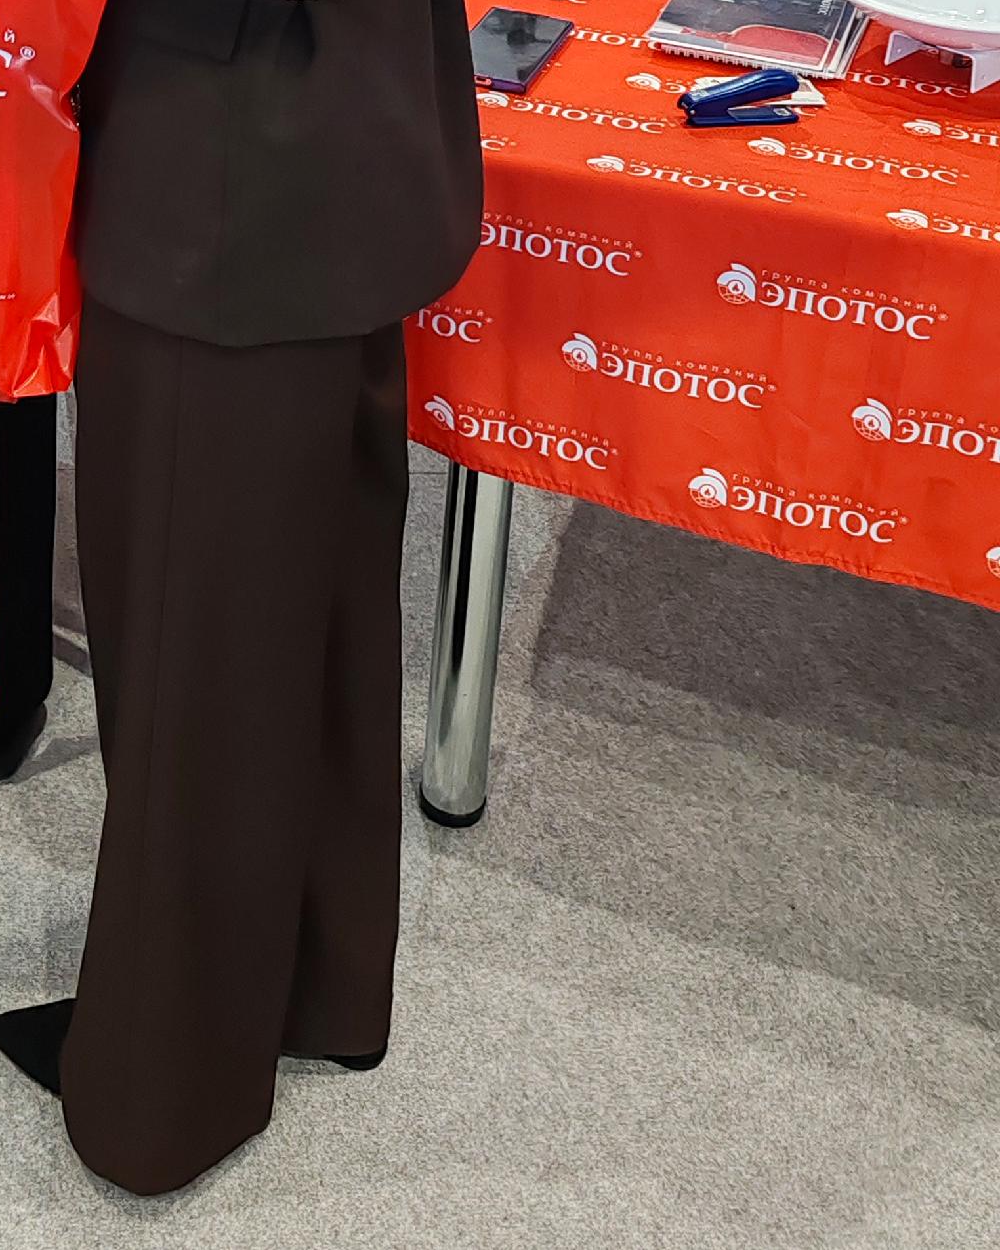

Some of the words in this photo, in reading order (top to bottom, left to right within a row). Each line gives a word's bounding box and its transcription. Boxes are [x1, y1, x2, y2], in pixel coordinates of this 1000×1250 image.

[511, 99, 666, 134] ЭПОТОС
[627, 164, 796, 204] ЭПОТОС
[789, 147, 958, 186] ЭПОТОС
[480, 221, 631, 277] ЭПОТОС
[484, 210, 534, 229] руппа
[545, 225, 633, 250] компаний
[758, 280, 935, 341] ЭПОТОС
[761, 269, 829, 290] группа
[841, 285, 938, 313] компаний
[599, 352, 766, 409] ЭПОТОС
[602, 339, 664, 363] группа
[676, 359, 768, 384] компаний
[526, 418, 610, 448] компаний
[897, 406, 966, 425] группа
[457, 414, 609, 471] ЭПОТОС
[729, 485, 897, 544] ЭПОТОС
[731, 472, 797, 497] группа
[808, 491, 900, 517] компаний
